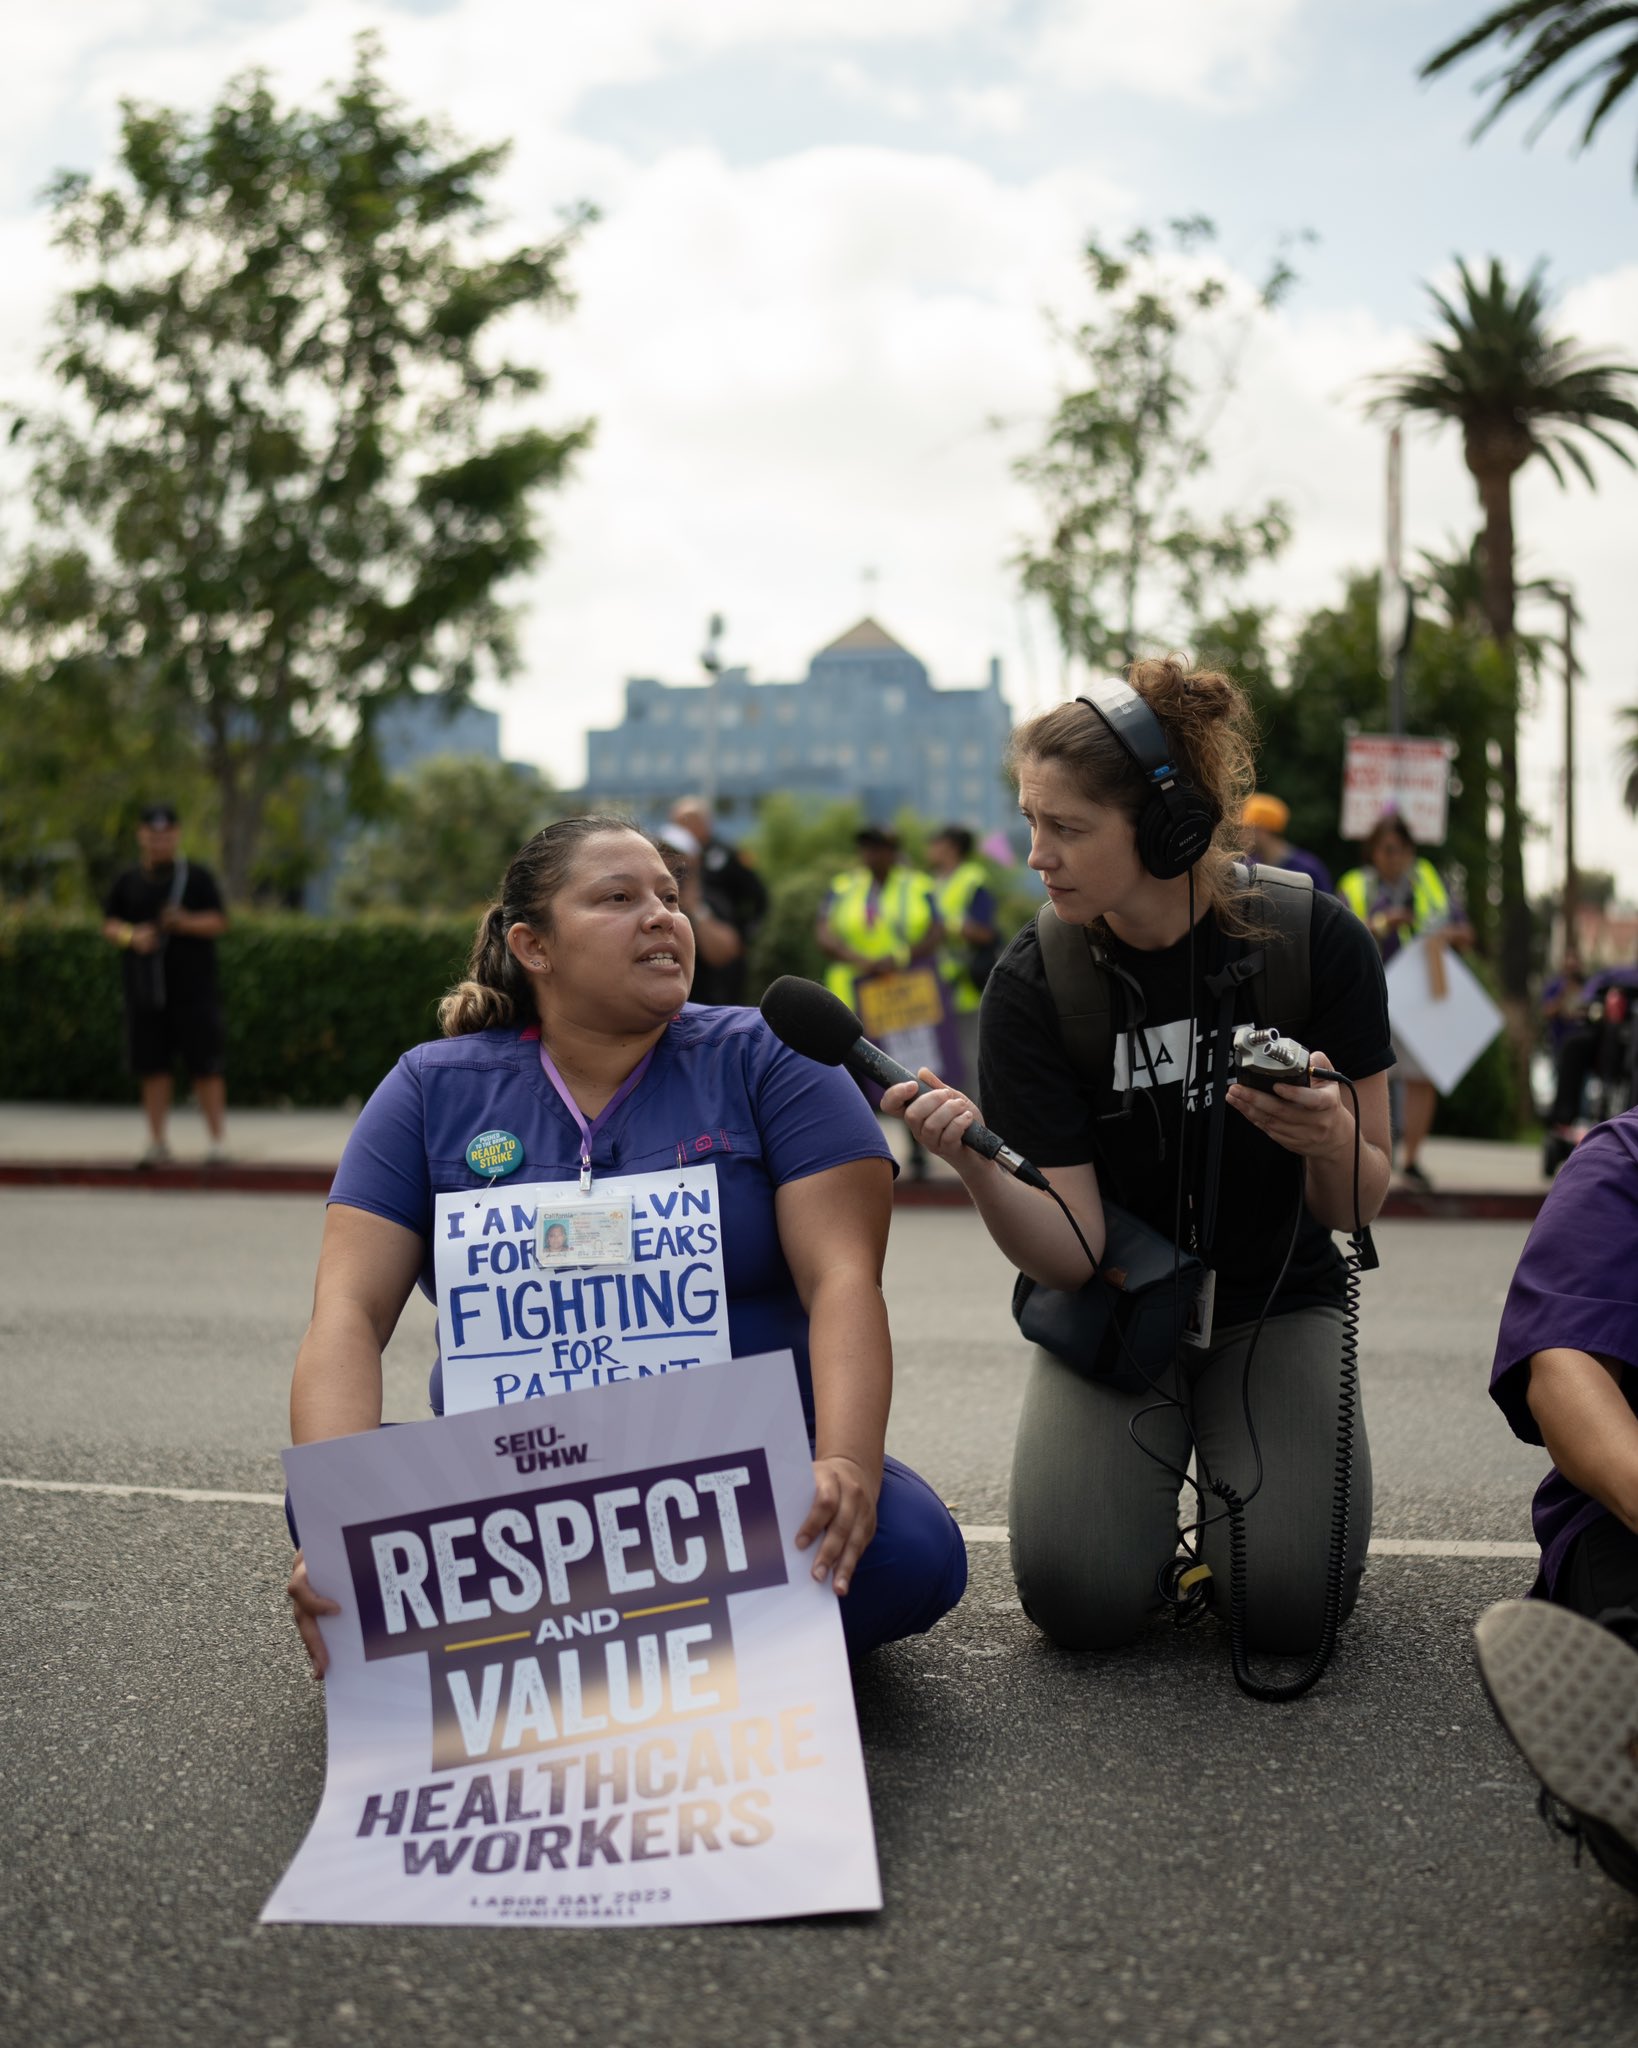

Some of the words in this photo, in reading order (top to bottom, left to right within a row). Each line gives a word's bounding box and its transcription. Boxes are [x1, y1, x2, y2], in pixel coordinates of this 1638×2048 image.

[471, 1143, 502, 1161] READY
[503, 1140, 516, 1151] TO
[480, 1150, 513, 1169] STRIKE
[447, 1211, 465, 1240] I
[482, 1205, 537, 1236] AM
[544, 1211, 574, 1219] California
[467, 1239, 536, 1276] FOR
[633, 1223, 718, 1263] EARS
[449, 1262, 719, 1348] FIGHTING
[551, 1335, 621, 1370] FOR
[494, 1426, 566, 1457] SEIU-
[515, 1443, 588, 1474] UHW
[370, 1466, 751, 1636] RESPECT
[535, 1607, 620, 1646] AND
[446, 1623, 720, 1758] VALUE
[356, 1703, 825, 1837] HEALTHCARE
[403, 1789, 775, 1875] WORKERS
[470, 1895, 548, 1908] LABOR
[558, 1894, 603, 1907] DAY
[614, 1887, 672, 1905] 2023
